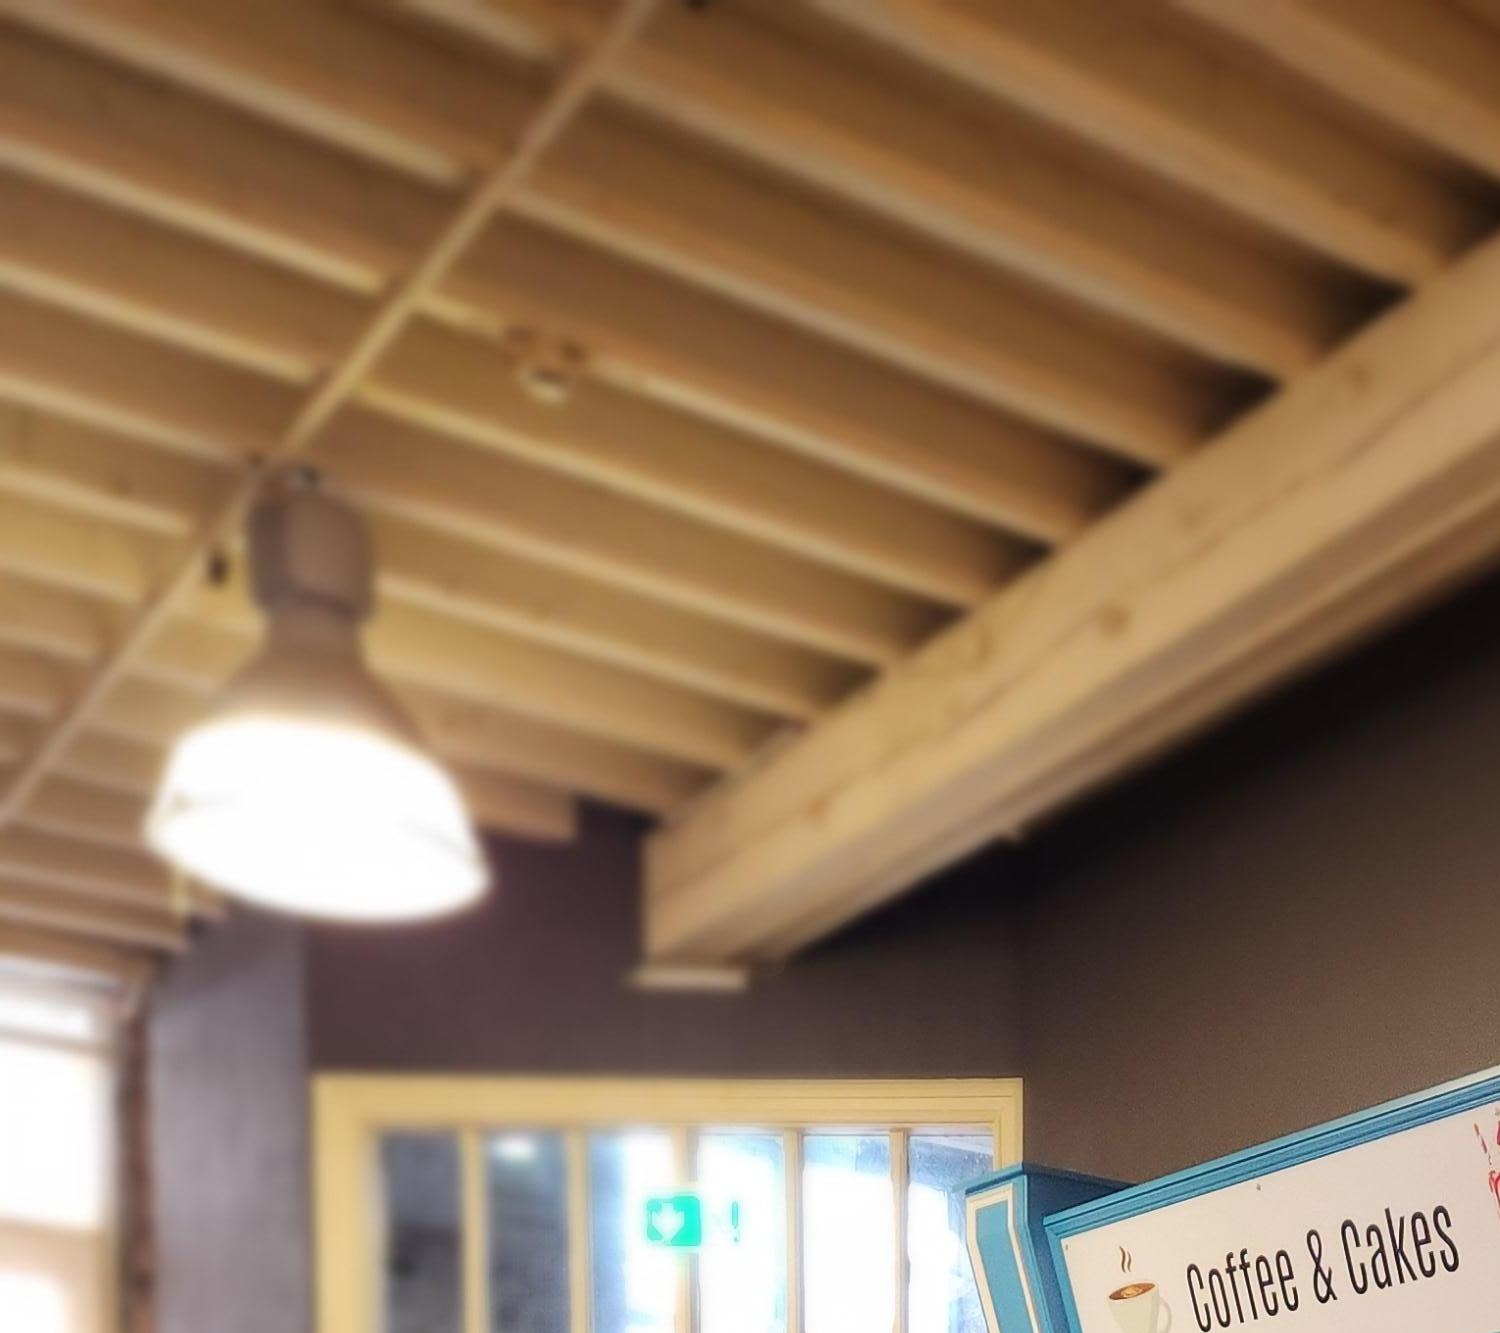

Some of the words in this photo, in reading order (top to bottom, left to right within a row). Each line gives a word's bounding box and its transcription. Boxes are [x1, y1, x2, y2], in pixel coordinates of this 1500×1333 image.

[1186, 1246, 1300, 1333] Coffee
[1306, 1228, 1338, 1304] &
[1340, 1203, 1460, 1295] Cakes
